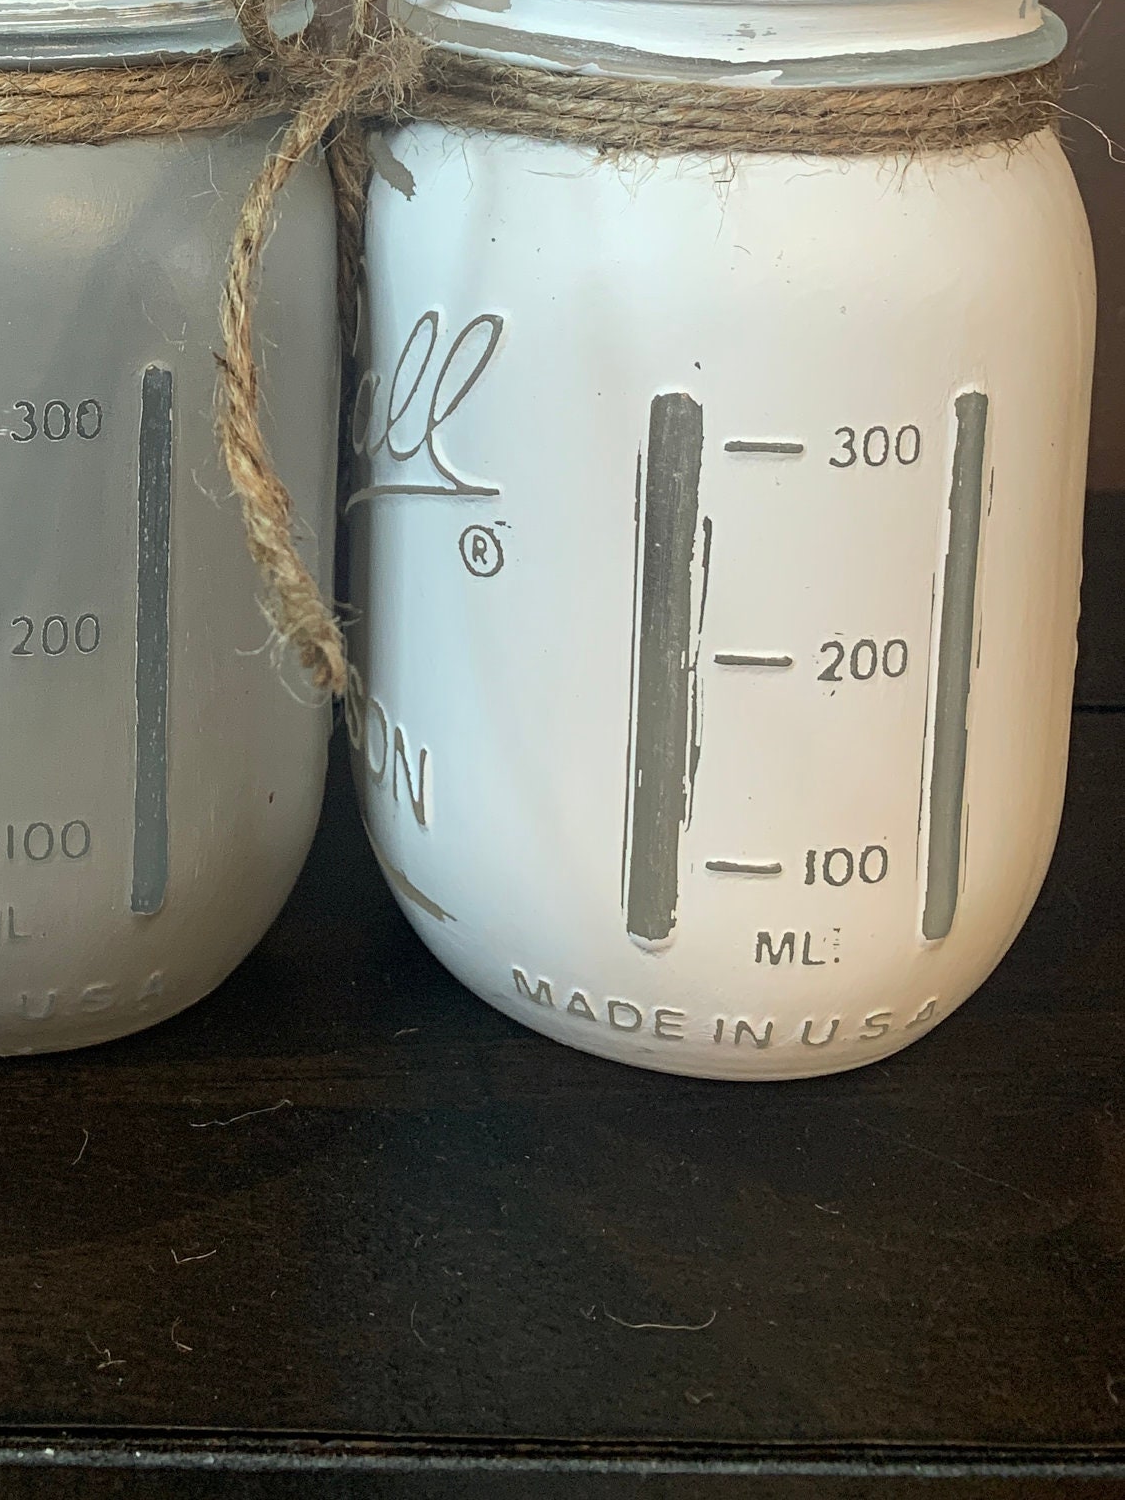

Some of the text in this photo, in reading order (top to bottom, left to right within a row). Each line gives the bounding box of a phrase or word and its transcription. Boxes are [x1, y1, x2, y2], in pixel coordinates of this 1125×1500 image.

[10, 398, 104, 443] 300
[828, 423, 922, 468] 300
[10, 613, 102, 656] 200
[817, 638, 909, 682] 200
[4, 819, 92, 862] 100
[803, 844, 890, 888] 100
[512, 967, 685, 1042] MADE
[712, 1017, 775, 1049] IN
